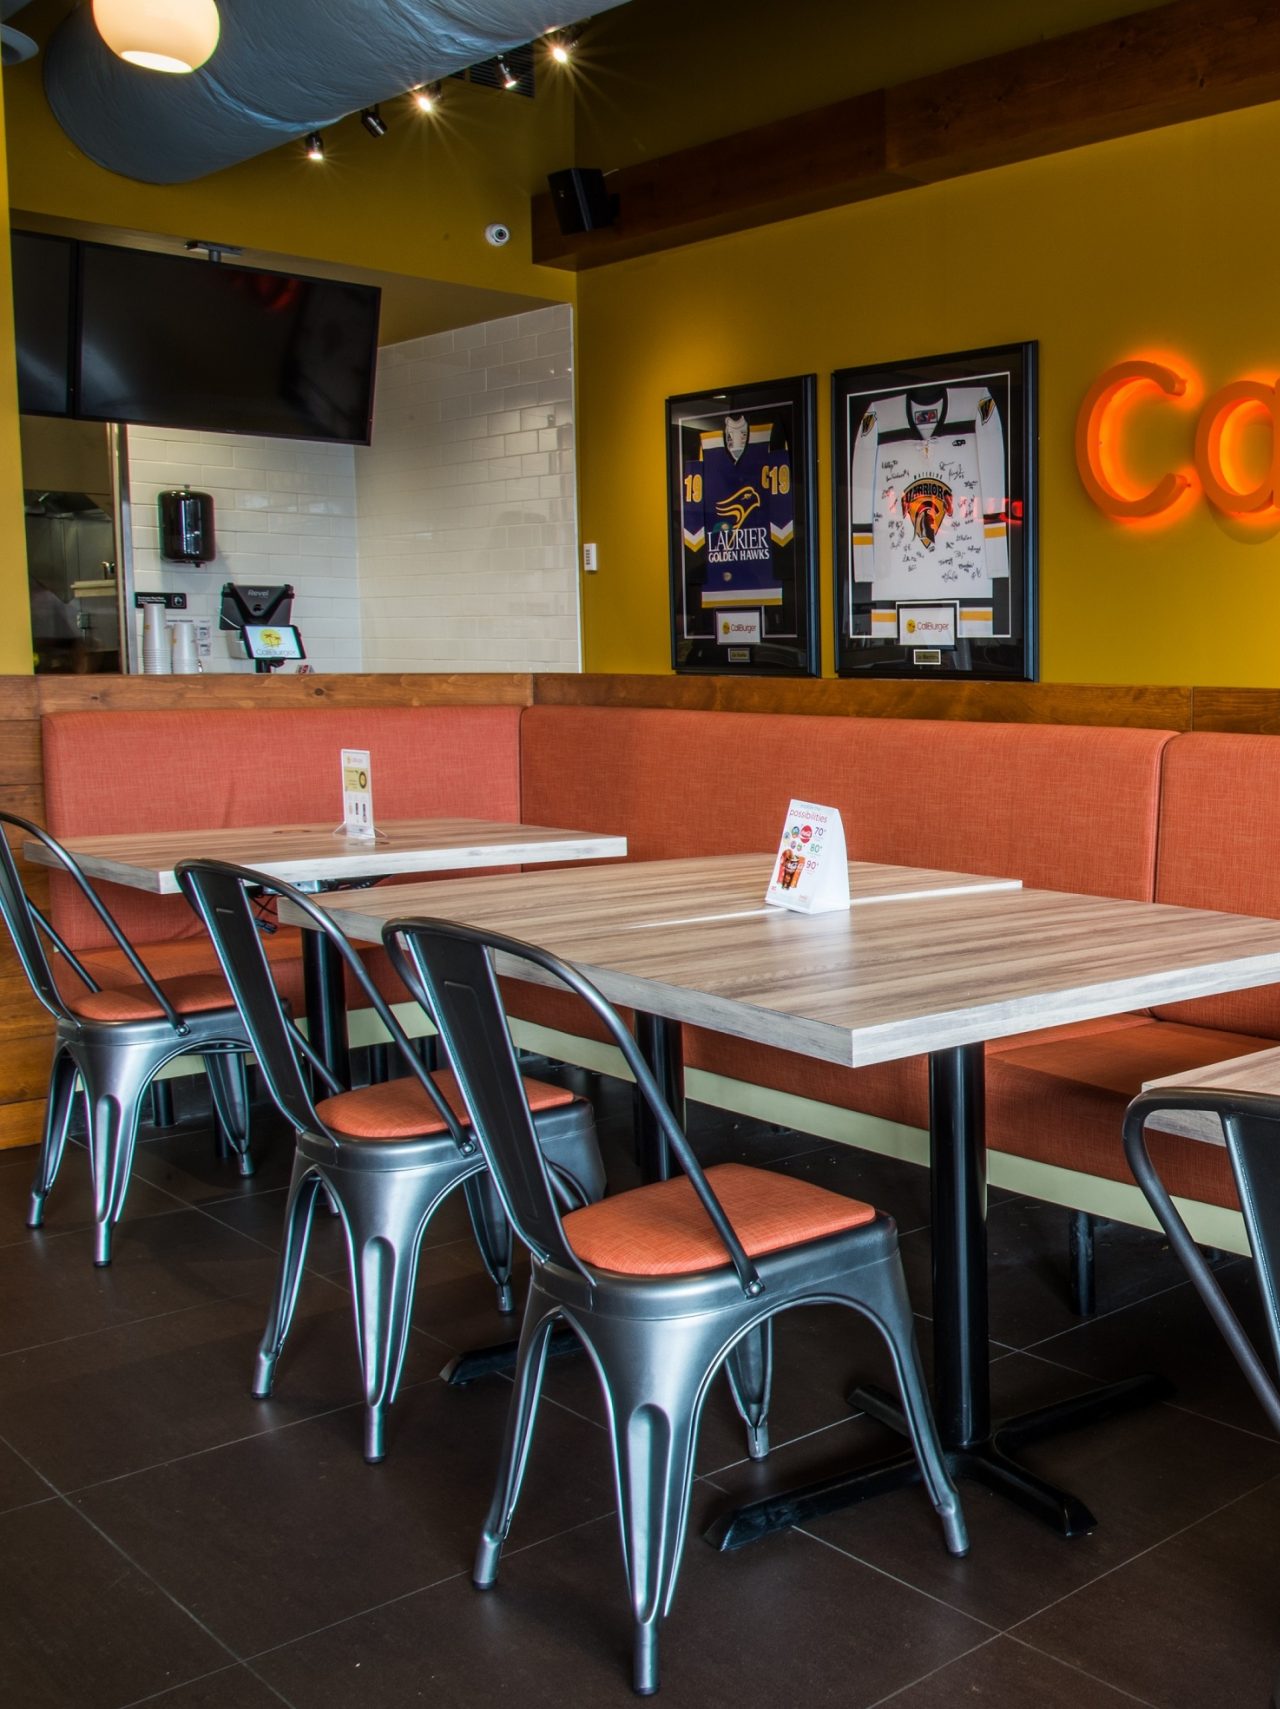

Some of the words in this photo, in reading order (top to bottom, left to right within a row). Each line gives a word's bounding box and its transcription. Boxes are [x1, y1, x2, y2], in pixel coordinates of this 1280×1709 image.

[684, 474, 703, 503] 19
[769, 464, 790, 494] 19
[707, 527, 769, 552] LAURIER
[708, 550, 738, 563] GOLDEN
[740, 549, 770, 561] HAWKS
[916, 621, 949, 631] CaliBurger
[789, 809, 828, 823] possibilities
